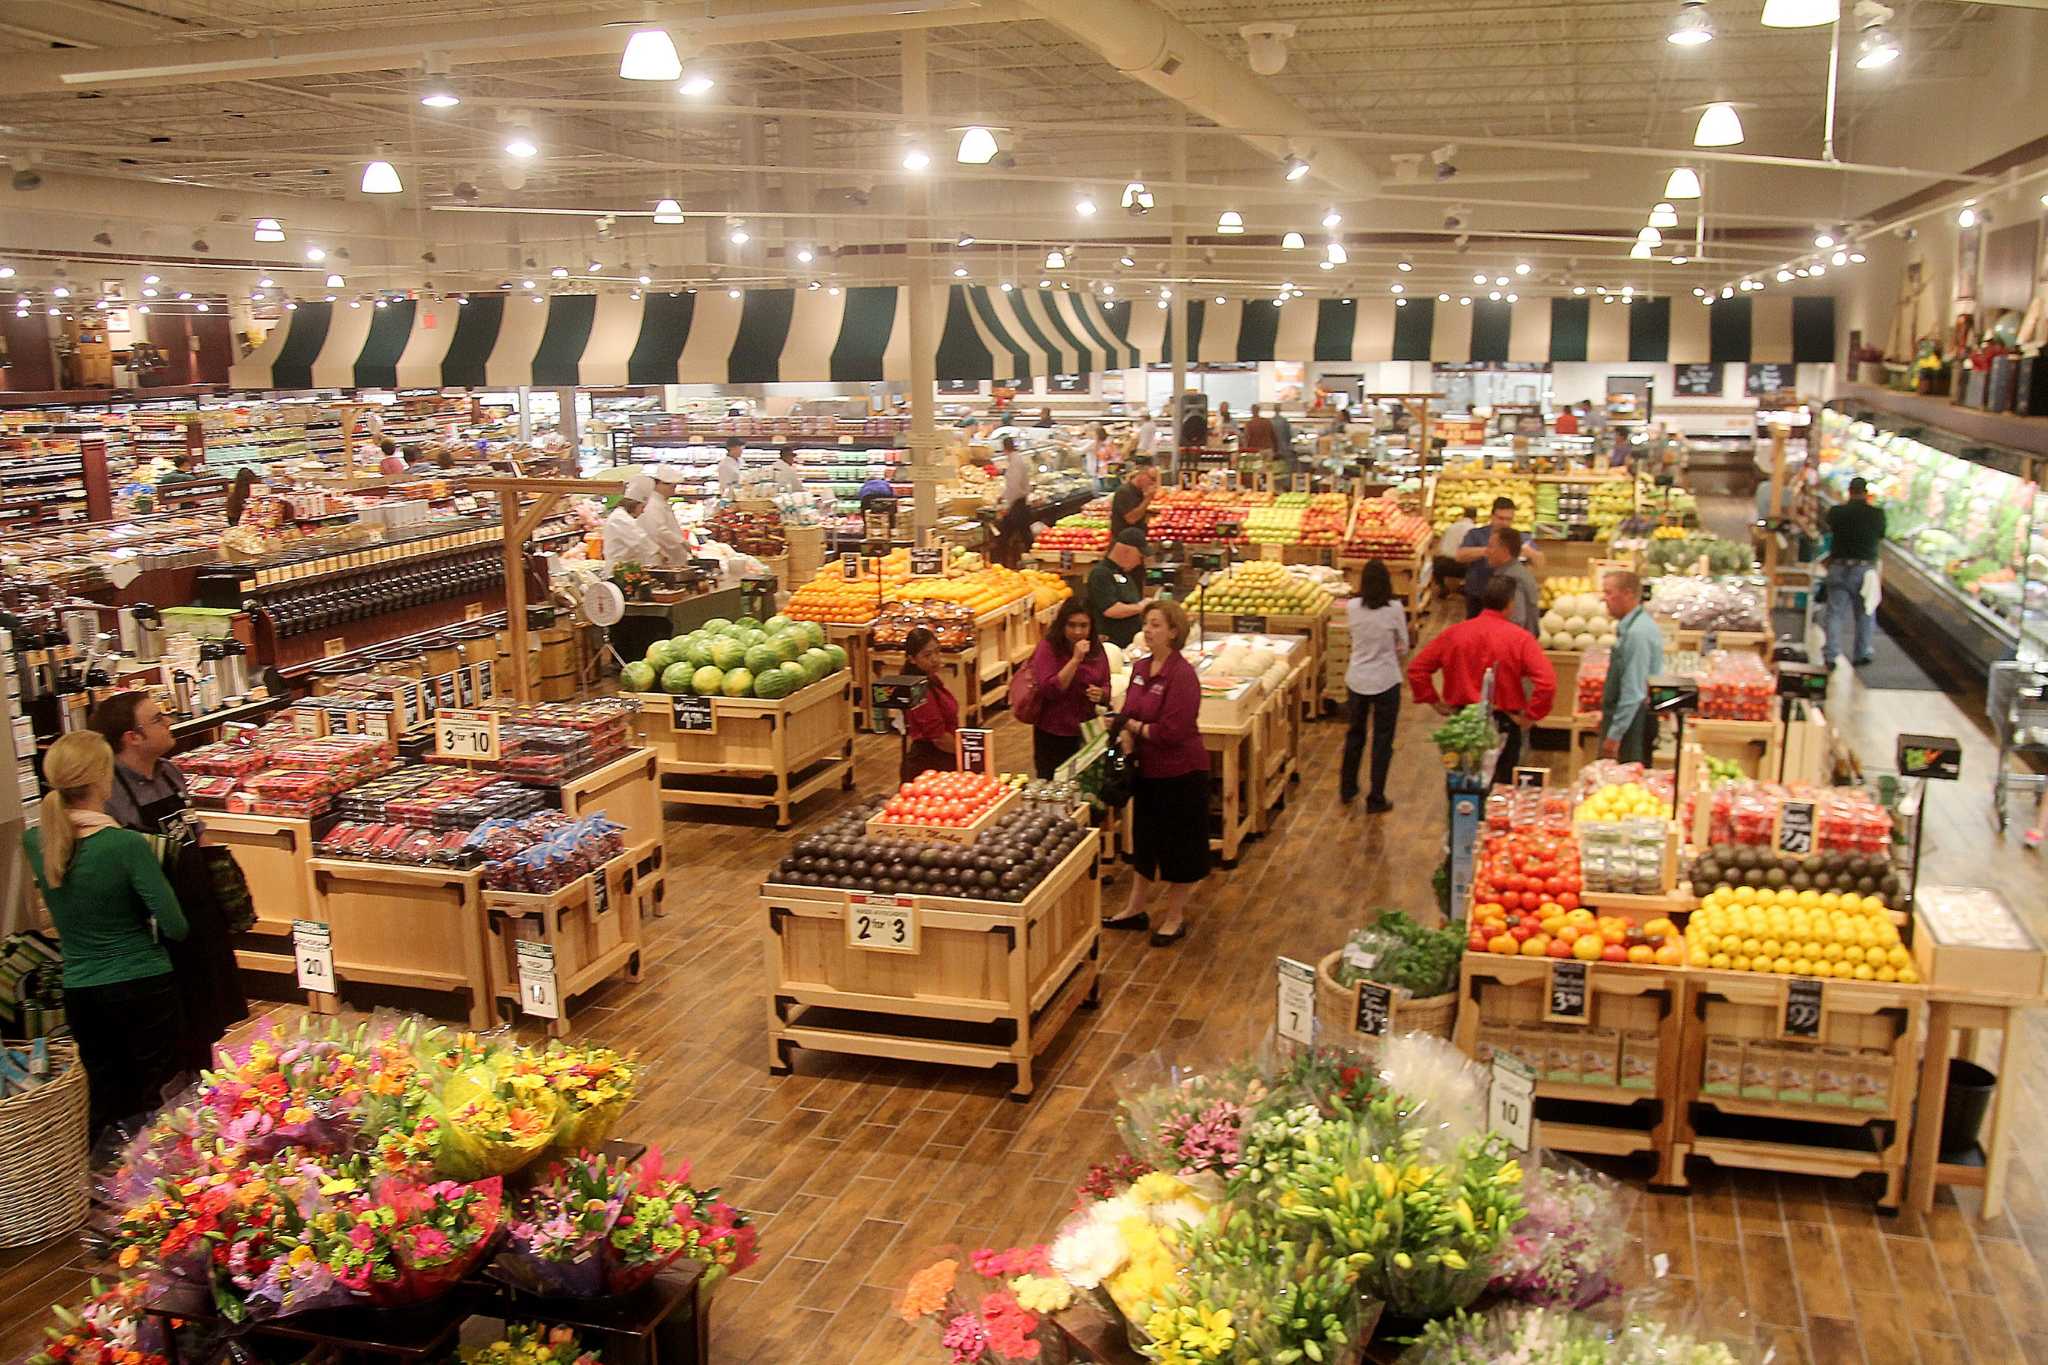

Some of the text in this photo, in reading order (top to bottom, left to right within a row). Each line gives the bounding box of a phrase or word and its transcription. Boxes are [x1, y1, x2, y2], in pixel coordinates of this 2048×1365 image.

[444, 729, 454, 750] 3
[470, 732, 489, 752] 10
[857, 916, 872, 940] 2
[892, 918, 905, 943] 3
[1290, 1011, 1299, 1031] 7
[1502, 1100, 1518, 1125] 10
